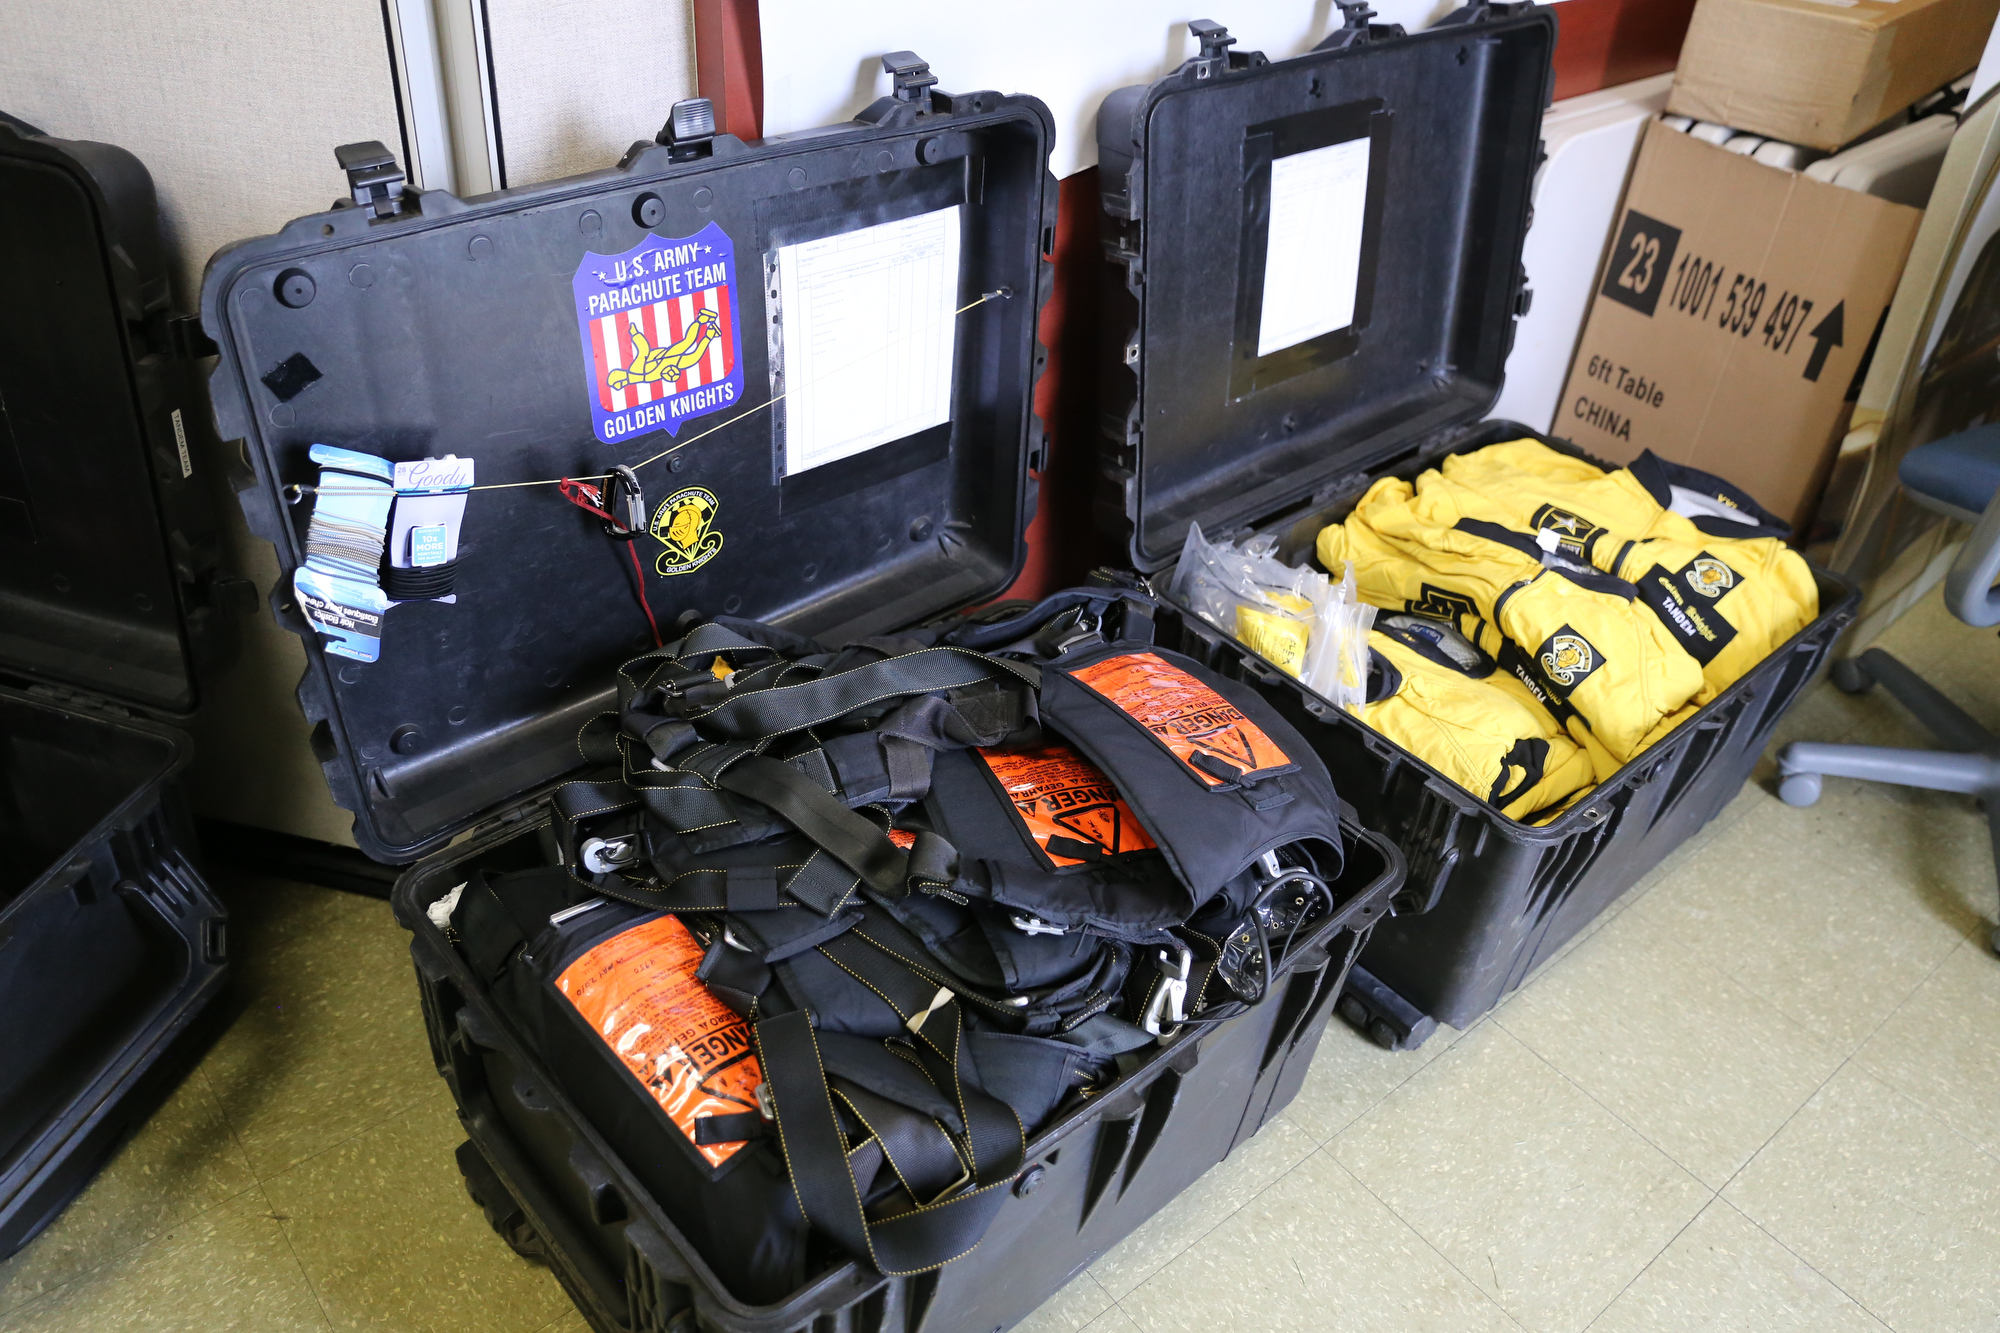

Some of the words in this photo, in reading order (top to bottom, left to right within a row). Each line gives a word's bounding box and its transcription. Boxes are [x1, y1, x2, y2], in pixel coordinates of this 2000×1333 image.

[614, 257, 649, 282] U.S.
[654, 242, 699, 272] ARMY
[1618, 232, 1660, 294] 23
[588, 276, 682, 316] PARACHUTE
[685, 262, 727, 290] TEAM
[1670, 252, 1724, 321] 1001
[1719, 274, 1767, 338] 539
[1763, 290, 1814, 355] 497
[1588, 355, 1612, 384] 6ft
[1616, 366, 1664, 408] Table
[604, 403, 666, 438] GOLDEN
[670, 382, 734, 418] KNIGHTS
[1574, 396, 1631, 442] CHINA
[174, 413, 185, 448] TANDEM
[181, 450, 190, 472] TEAM
[409, 462, 466, 492] Goody
[657, 504, 670, 519] ARMY
[670, 491, 703, 505] PARACHUTE
[703, 493, 715, 506] TEAM
[416, 542, 444, 552] MORE
[422, 535, 438, 543] 10x
[666, 565, 692, 573] GOLDEN
[692, 548, 717, 567] KNIGHTS
[314, 610, 340, 624] Elastics
[340, 617, 355, 628] Hair
[1662, 596, 1696, 636] TANDEM
[1170, 707, 1245, 734] DANGER
[1021, 783, 1065, 798] GEFAHR
[600, 962, 614, 979] MAY
